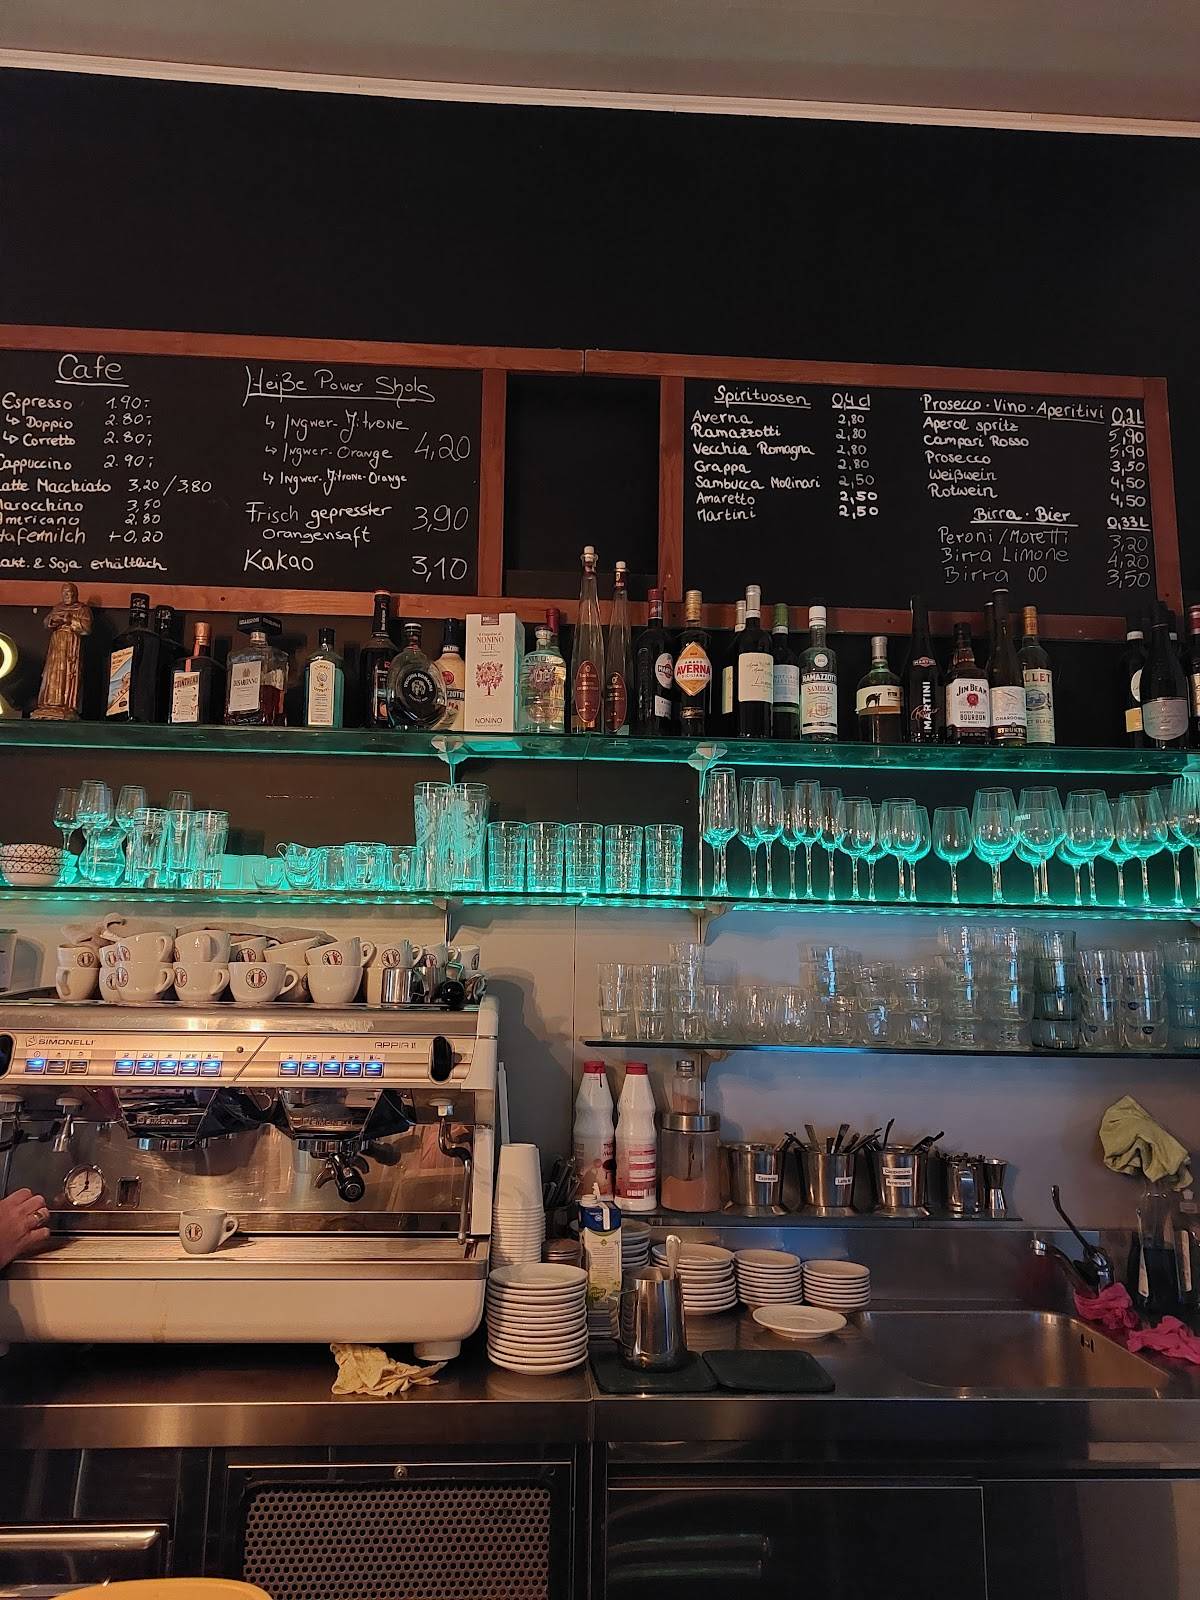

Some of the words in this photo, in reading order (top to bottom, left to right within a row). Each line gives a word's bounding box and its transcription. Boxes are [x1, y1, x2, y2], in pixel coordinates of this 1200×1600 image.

[58, 354, 124, 380] Cafe
[314, 369, 363, 392] Power
[375, 376, 435, 408] Shots
[714, 385, 811, 408] Spirituosen
[2, 392, 73, 416] Espresso
[920, 394, 981, 411] Prosecco
[993, 399, 1026, 413] Vino
[1036, 402, 1104, 421] Aperitivi
[26, 416, 73, 432] Doppio
[692, 410, 753, 424] Averna
[838, 414, 864, 427] 2,80
[923, 417, 969, 434] Aperol
[23, 434, 75, 446] Corretto
[691, 425, 781, 439] Ramazzotti
[835, 429, 866, 441] 2,80
[924, 435, 984, 447] Campari
[990, 435, 1029, 447] Rosso
[414, 431, 471, 461] 4,20
[757, 441, 815, 461] Romagna
[837, 445, 866, 456] 2,80
[694, 460, 751, 475] Grappa
[925, 450, 991, 464] Prosecco
[1109, 461, 1145, 476] 3,50
[0, 479, 30, 492] atte
[37, 478, 111, 493] Macchiato
[695, 475, 765, 490] Sambucca
[771, 476, 821, 489] Molinari
[839, 474, 874, 489] 2,50
[1111, 477, 1145, 491] 4,50
[696, 492, 755, 505] Amaretto
[839, 491, 878, 504] 2,50
[928, 483, 998, 498] Rotwein
[1111, 493, 1146, 508] 4,50
[127, 500, 160, 513] 3,50
[697, 507, 756, 523] Martini
[839, 506, 879, 520] 2,50
[973, 508, 1022, 521] Birra
[1035, 506, 1070, 522] Bier
[246, 501, 299, 523] Frisch
[306, 502, 393, 529] gepresster
[412, 505, 469, 532] 3,90
[1109, 535, 1147, 552] 3,20
[0, 557, 30, 568] akt.
[34, 558, 45, 568] &
[49, 557, 82, 573] Soja
[90, 556, 167, 571] erhältlich
[244, 549, 314, 572] Kakao
[411, 556, 468, 583] 3,10
[941, 548, 991, 564] Birra
[1003, 547, 1069, 562] Limone
[1107, 552, 1149, 569] 4,20
[945, 567, 1009, 583] Birra
[1107, 569, 1150, 588] 3,50
[676, 664, 711, 676] AVERNA
[956, 685, 969, 697] JIM
[922, 681, 932, 730] MARTINI
